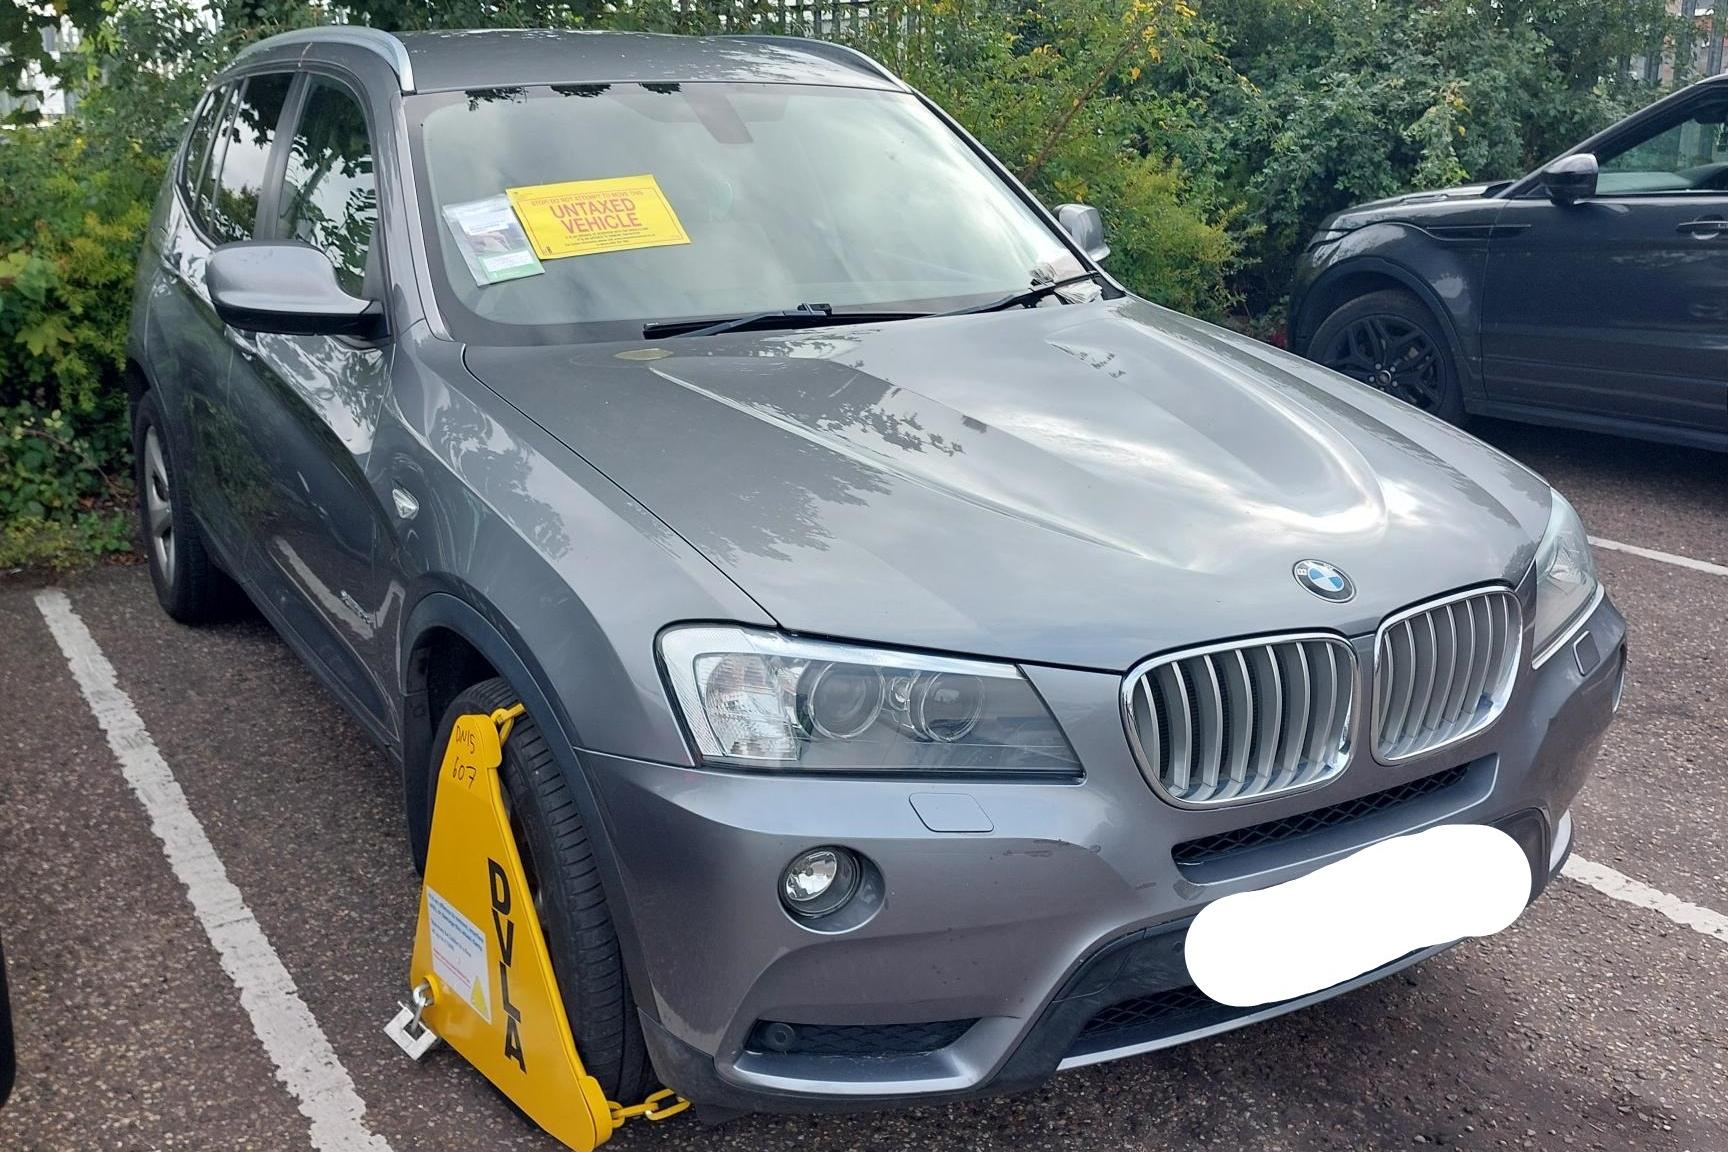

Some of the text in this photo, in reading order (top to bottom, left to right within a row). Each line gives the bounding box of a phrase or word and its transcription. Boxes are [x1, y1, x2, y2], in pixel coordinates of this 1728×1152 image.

[550, 198, 636, 219] UNTAXED
[560, 213, 642, 234] VEHICLE
[453, 756, 477, 789] 607
[487, 857, 527, 1074] DVLA
